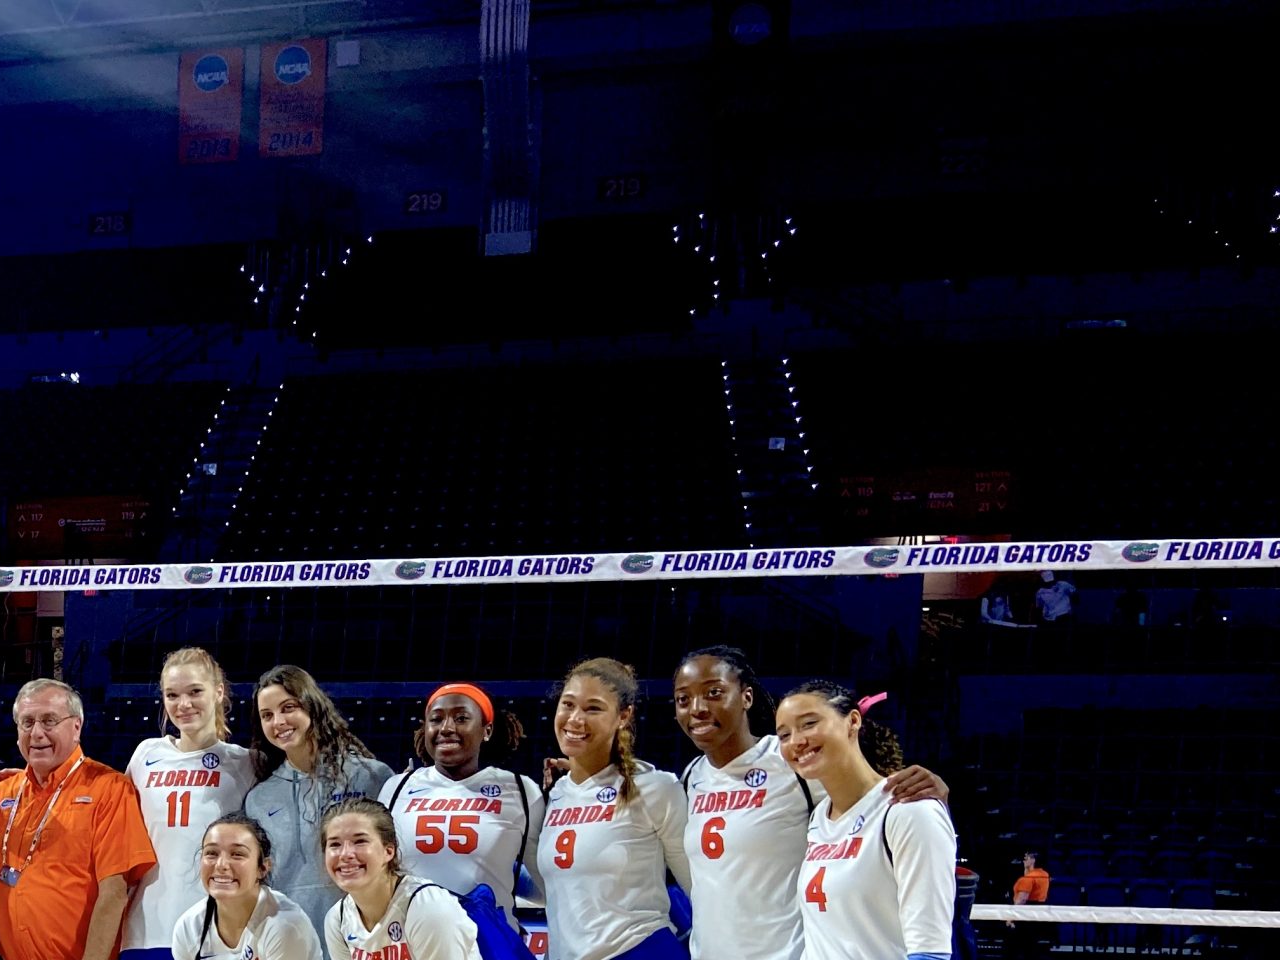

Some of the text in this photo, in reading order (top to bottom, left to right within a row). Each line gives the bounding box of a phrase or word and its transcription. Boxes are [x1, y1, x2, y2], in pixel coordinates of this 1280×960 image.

[279, 62, 309, 75] NCAA
[269, 131, 314, 152] 2014
[407, 192, 443, 212] 219
[659, 550, 836, 573] FLORIDA GATORS
[905, 543, 1093, 567] FLORIDA GATORS
[1165, 540, 1264, 561] FLORIDA
[19, 567, 162, 586] FLORIDA GATORS
[218, 562, 372, 583] FLORIDA GATORS
[431, 556, 595, 579] FLORIDA GATORS
[145, 769, 221, 788] FLORIDA
[166, 790, 191, 827] 11
[404, 797, 502, 815] FLORIDA
[691, 789, 767, 815] FLORIDA
[545, 804, 617, 827] FLORIDA
[415, 815, 480, 855] 55
[701, 816, 727, 860] 6
[554, 829, 577, 870] 9
[805, 866, 827, 912] 4
